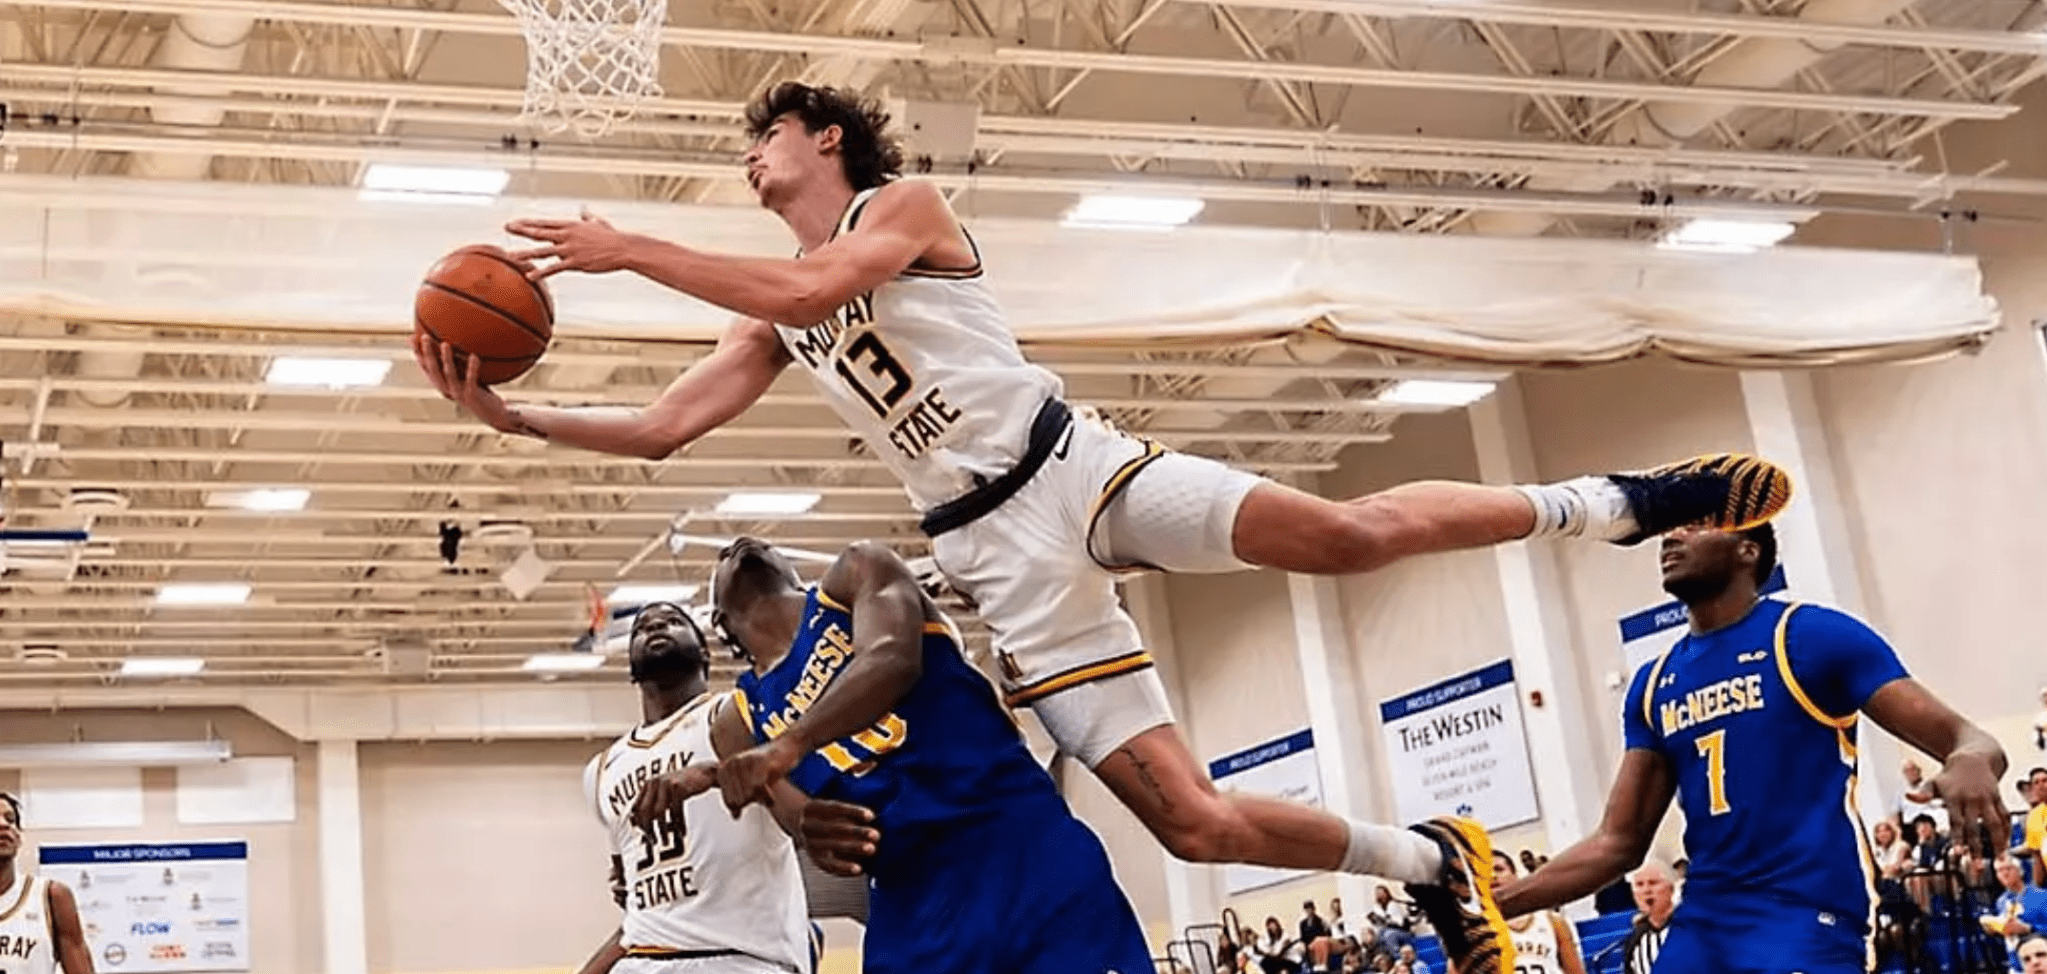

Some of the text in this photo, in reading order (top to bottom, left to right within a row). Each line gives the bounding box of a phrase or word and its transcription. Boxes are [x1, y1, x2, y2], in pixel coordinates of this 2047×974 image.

[795, 289, 874, 370] MUAY
[834, 331, 914, 419] 13
[888, 387, 962, 459] STATE
[1654, 605, 1688, 628] PROU
[1399, 703, 1503, 753] THE WESTIN
[1660, 673, 1765, 738] McNEESE
[1694, 728, 1732, 816] 1
[634, 865, 699, 911] STATE
